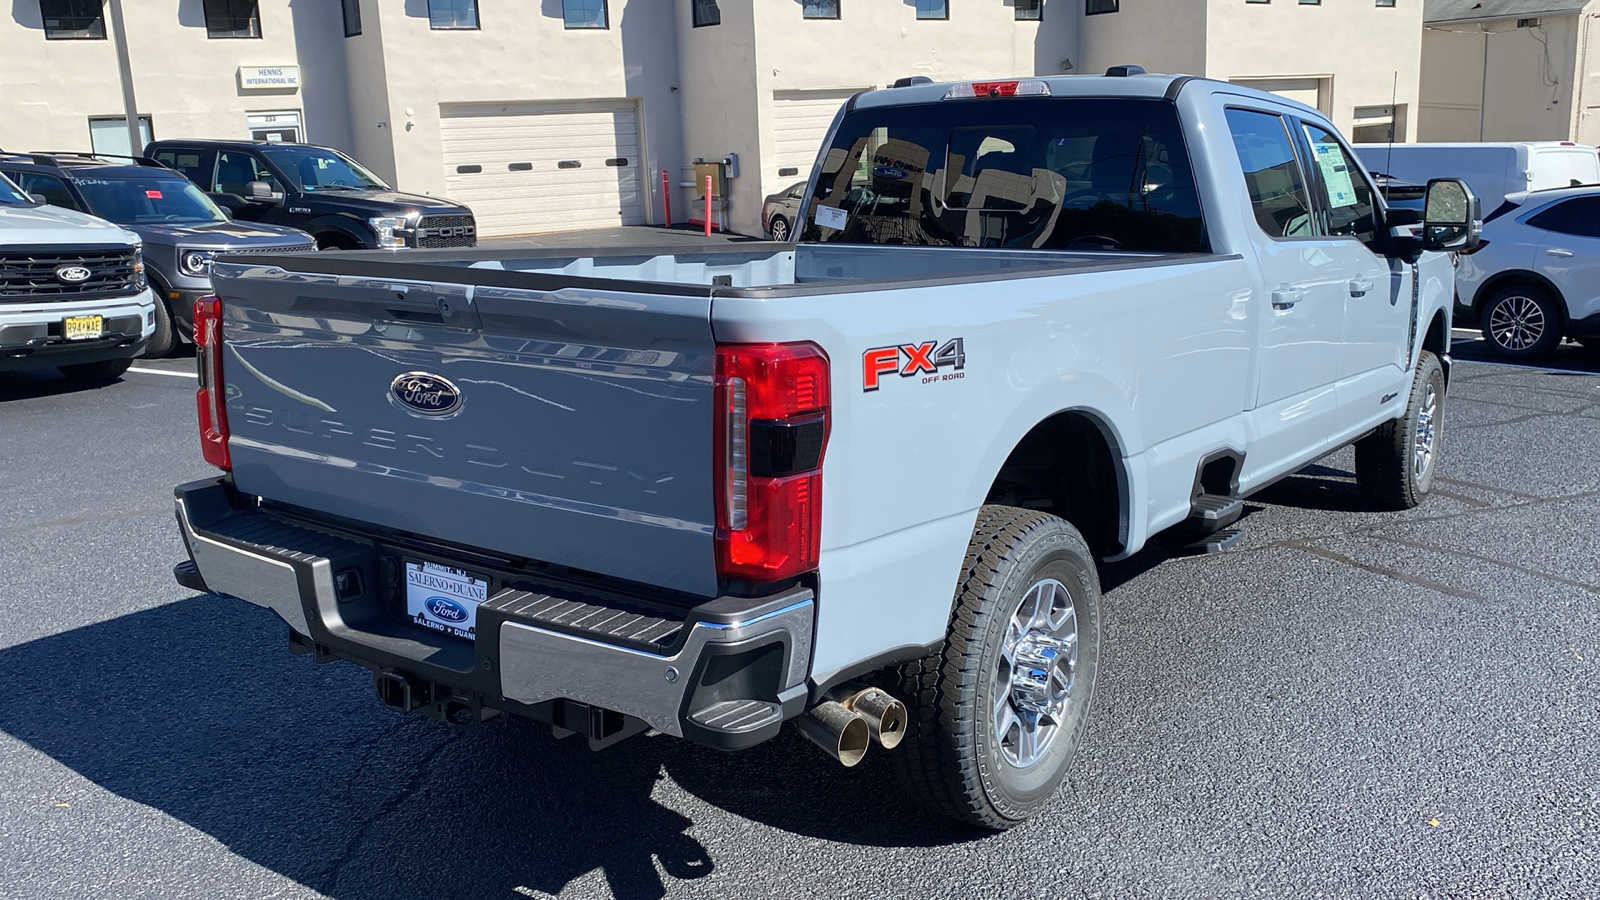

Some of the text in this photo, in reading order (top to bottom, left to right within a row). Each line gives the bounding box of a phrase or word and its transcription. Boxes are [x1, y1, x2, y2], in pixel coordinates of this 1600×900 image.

[420, 226, 475, 237] FORD
[862, 337, 966, 393] FX4
[921, 372, 965, 384] OFF ROAD
[404, 379, 443, 406] Ford
[245, 407, 675, 495] SUPER DUTY
[456, 569, 466, 577] NJ
[408, 571, 485, 600] SALERNO DUANE
[433, 599, 460, 619] Ford
[413, 616, 445, 631] SALERNO
